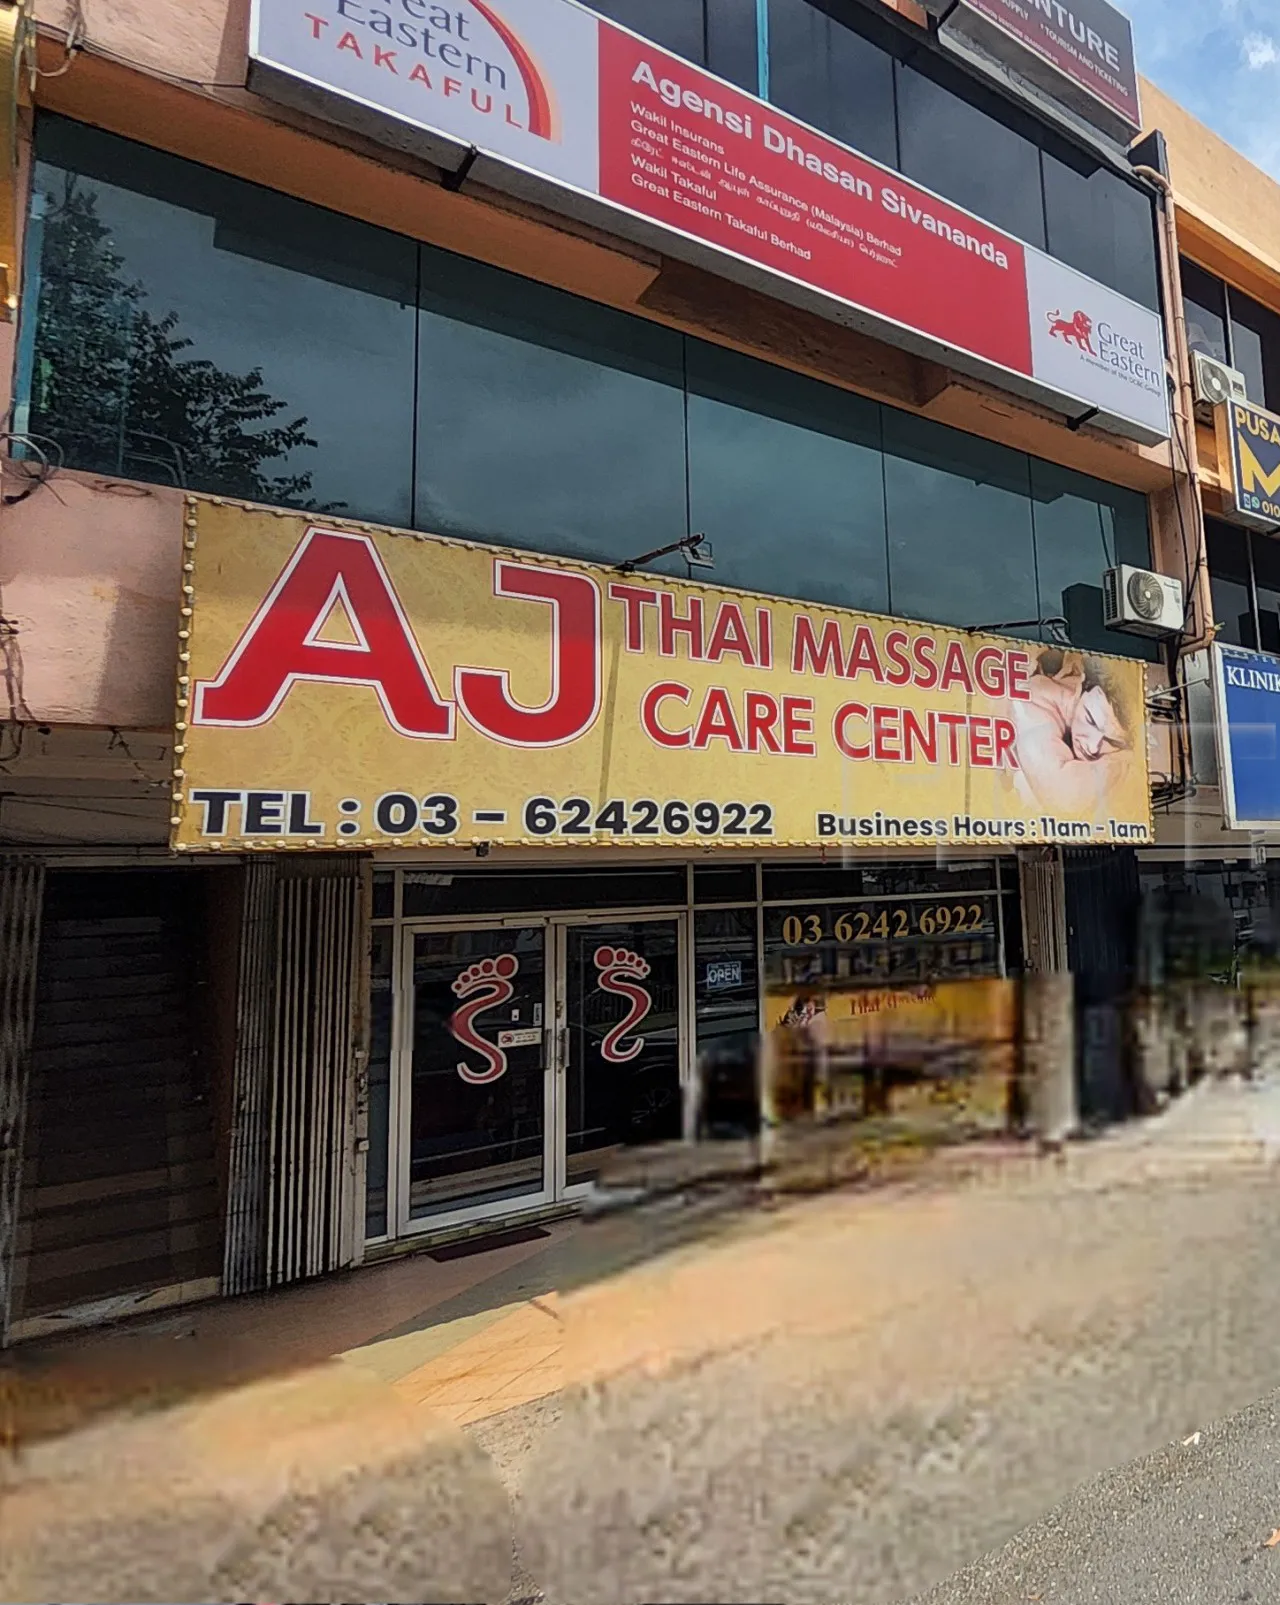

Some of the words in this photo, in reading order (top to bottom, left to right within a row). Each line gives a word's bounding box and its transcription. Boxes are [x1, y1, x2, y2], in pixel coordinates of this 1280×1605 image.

[382, 0, 470, 41] eat
[1027, 0, 1121, 73] NTURE
[304, 13, 523, 130] TAKAFUL
[1078, 53, 1094, 70] AND
[631, 100, 668, 128] Wakil
[670, 120, 725, 155] Insurans
[631, 61, 753, 139] Agensi
[763, 124, 873, 201] Dhasan
[881, 188, 1009, 270] Sivananda
[631, 153, 668, 179] Wakil
[671, 171, 718, 200] Takaful
[631, 119, 669, 146] Great
[672, 138, 721, 169] Eastern
[723, 161, 746, 181] Life
[748, 175, 809, 212] Assurance
[810, 204, 864, 240] (Malaysia)
[866, 231, 902, 257] Berhad
[631, 173, 670, 199] Great
[673, 190, 722, 221] Eastern
[725, 212, 768, 241] Takaful
[770, 233, 812, 260] Berhad
[1097, 322, 1145, 361] Great
[1099, 340, 1160, 387] Eastern
[190, 524, 603, 750] AJ
[606, 580, 773, 670] THAI
[791, 614, 1031, 703] MASSAGE
[641, 679, 817, 759] CARE
[831, 701, 1020, 771] CENTER
[374, 791, 460, 837] 03
[523, 797, 774, 838] 62426922
[817, 811, 948, 837] Business
[1041, 816, 1091, 838] 11am
[1108, 819, 1147, 839] 1am
[782, 914, 823, 946] 03
[833, 909, 910, 944] 6242
[918, 904, 984, 935] 6922
[708, 967, 740, 983] OPEN
